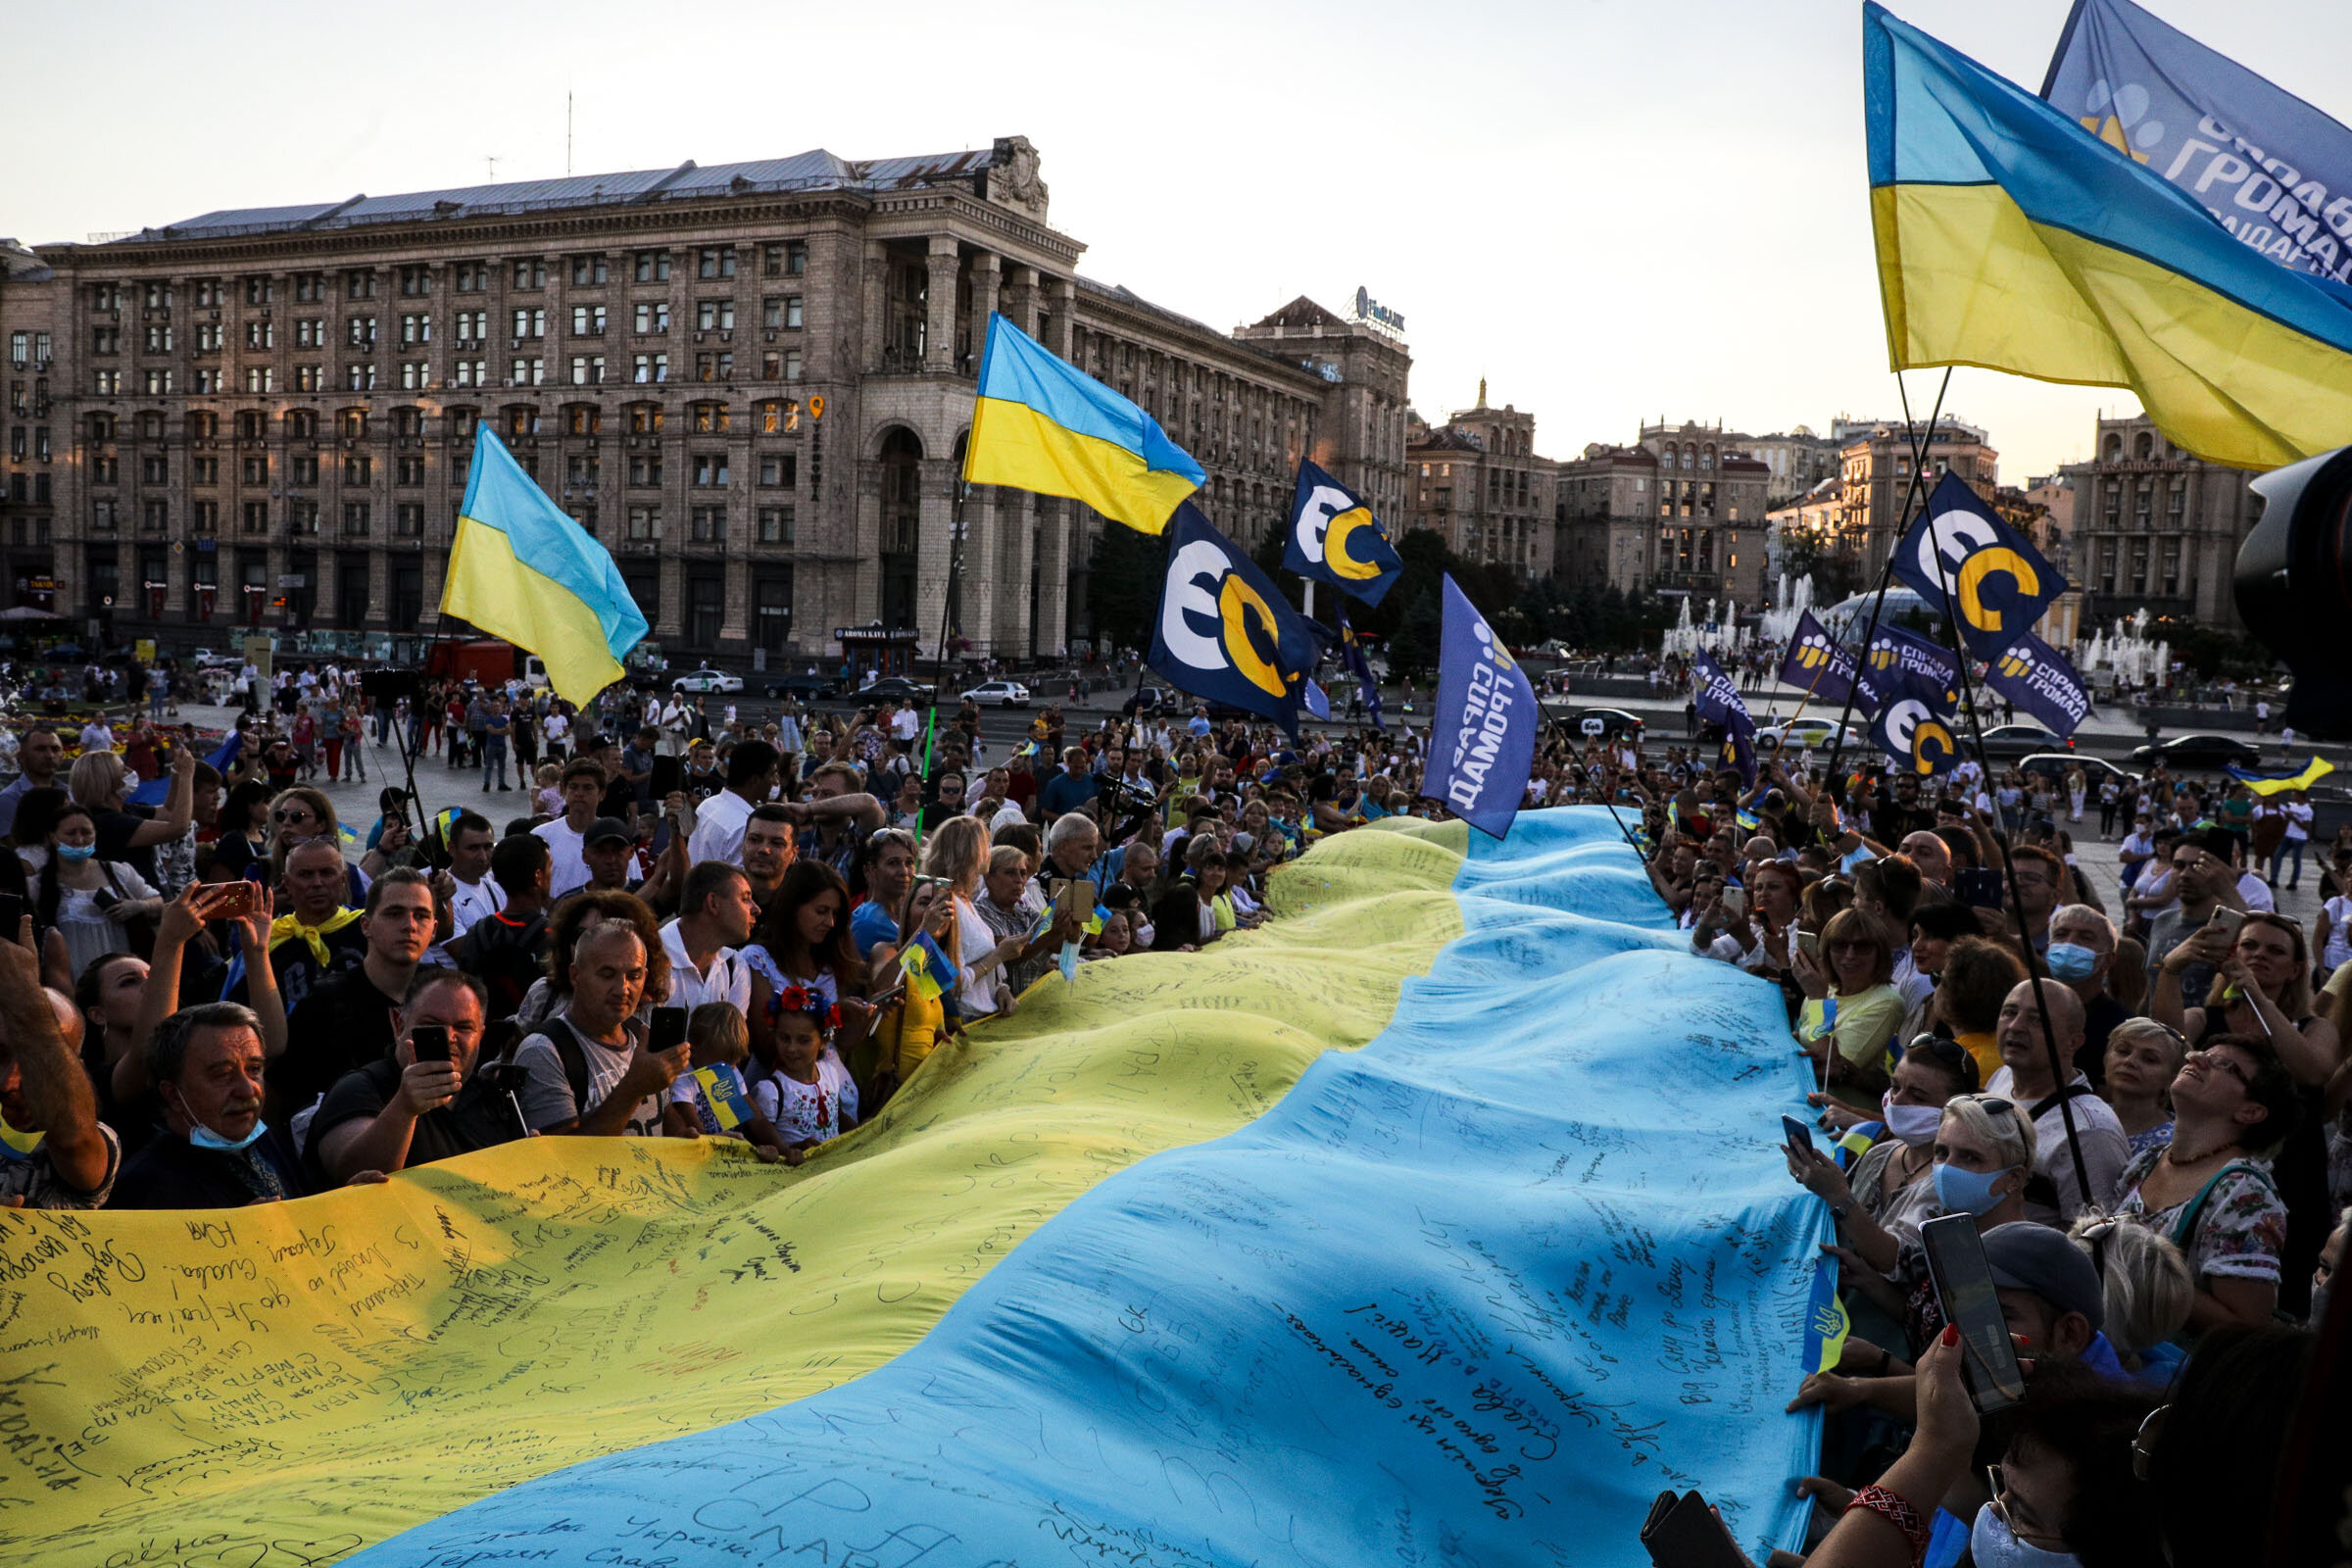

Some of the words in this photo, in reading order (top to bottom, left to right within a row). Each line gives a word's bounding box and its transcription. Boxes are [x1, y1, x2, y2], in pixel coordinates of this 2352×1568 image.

[1297, 485, 1382, 579] ЄС
[1918, 509, 2038, 632] ЄС
[1162, 540, 1286, 698] ЄС
[2026, 673, 2083, 722] ГРОМАД
[2036, 662, 2087, 711] СПРАВА
[1885, 699, 1954, 774] ЄС
[186, 1219, 237, 1250] Юля
[1472, 1382, 1558, 1461] Слава
